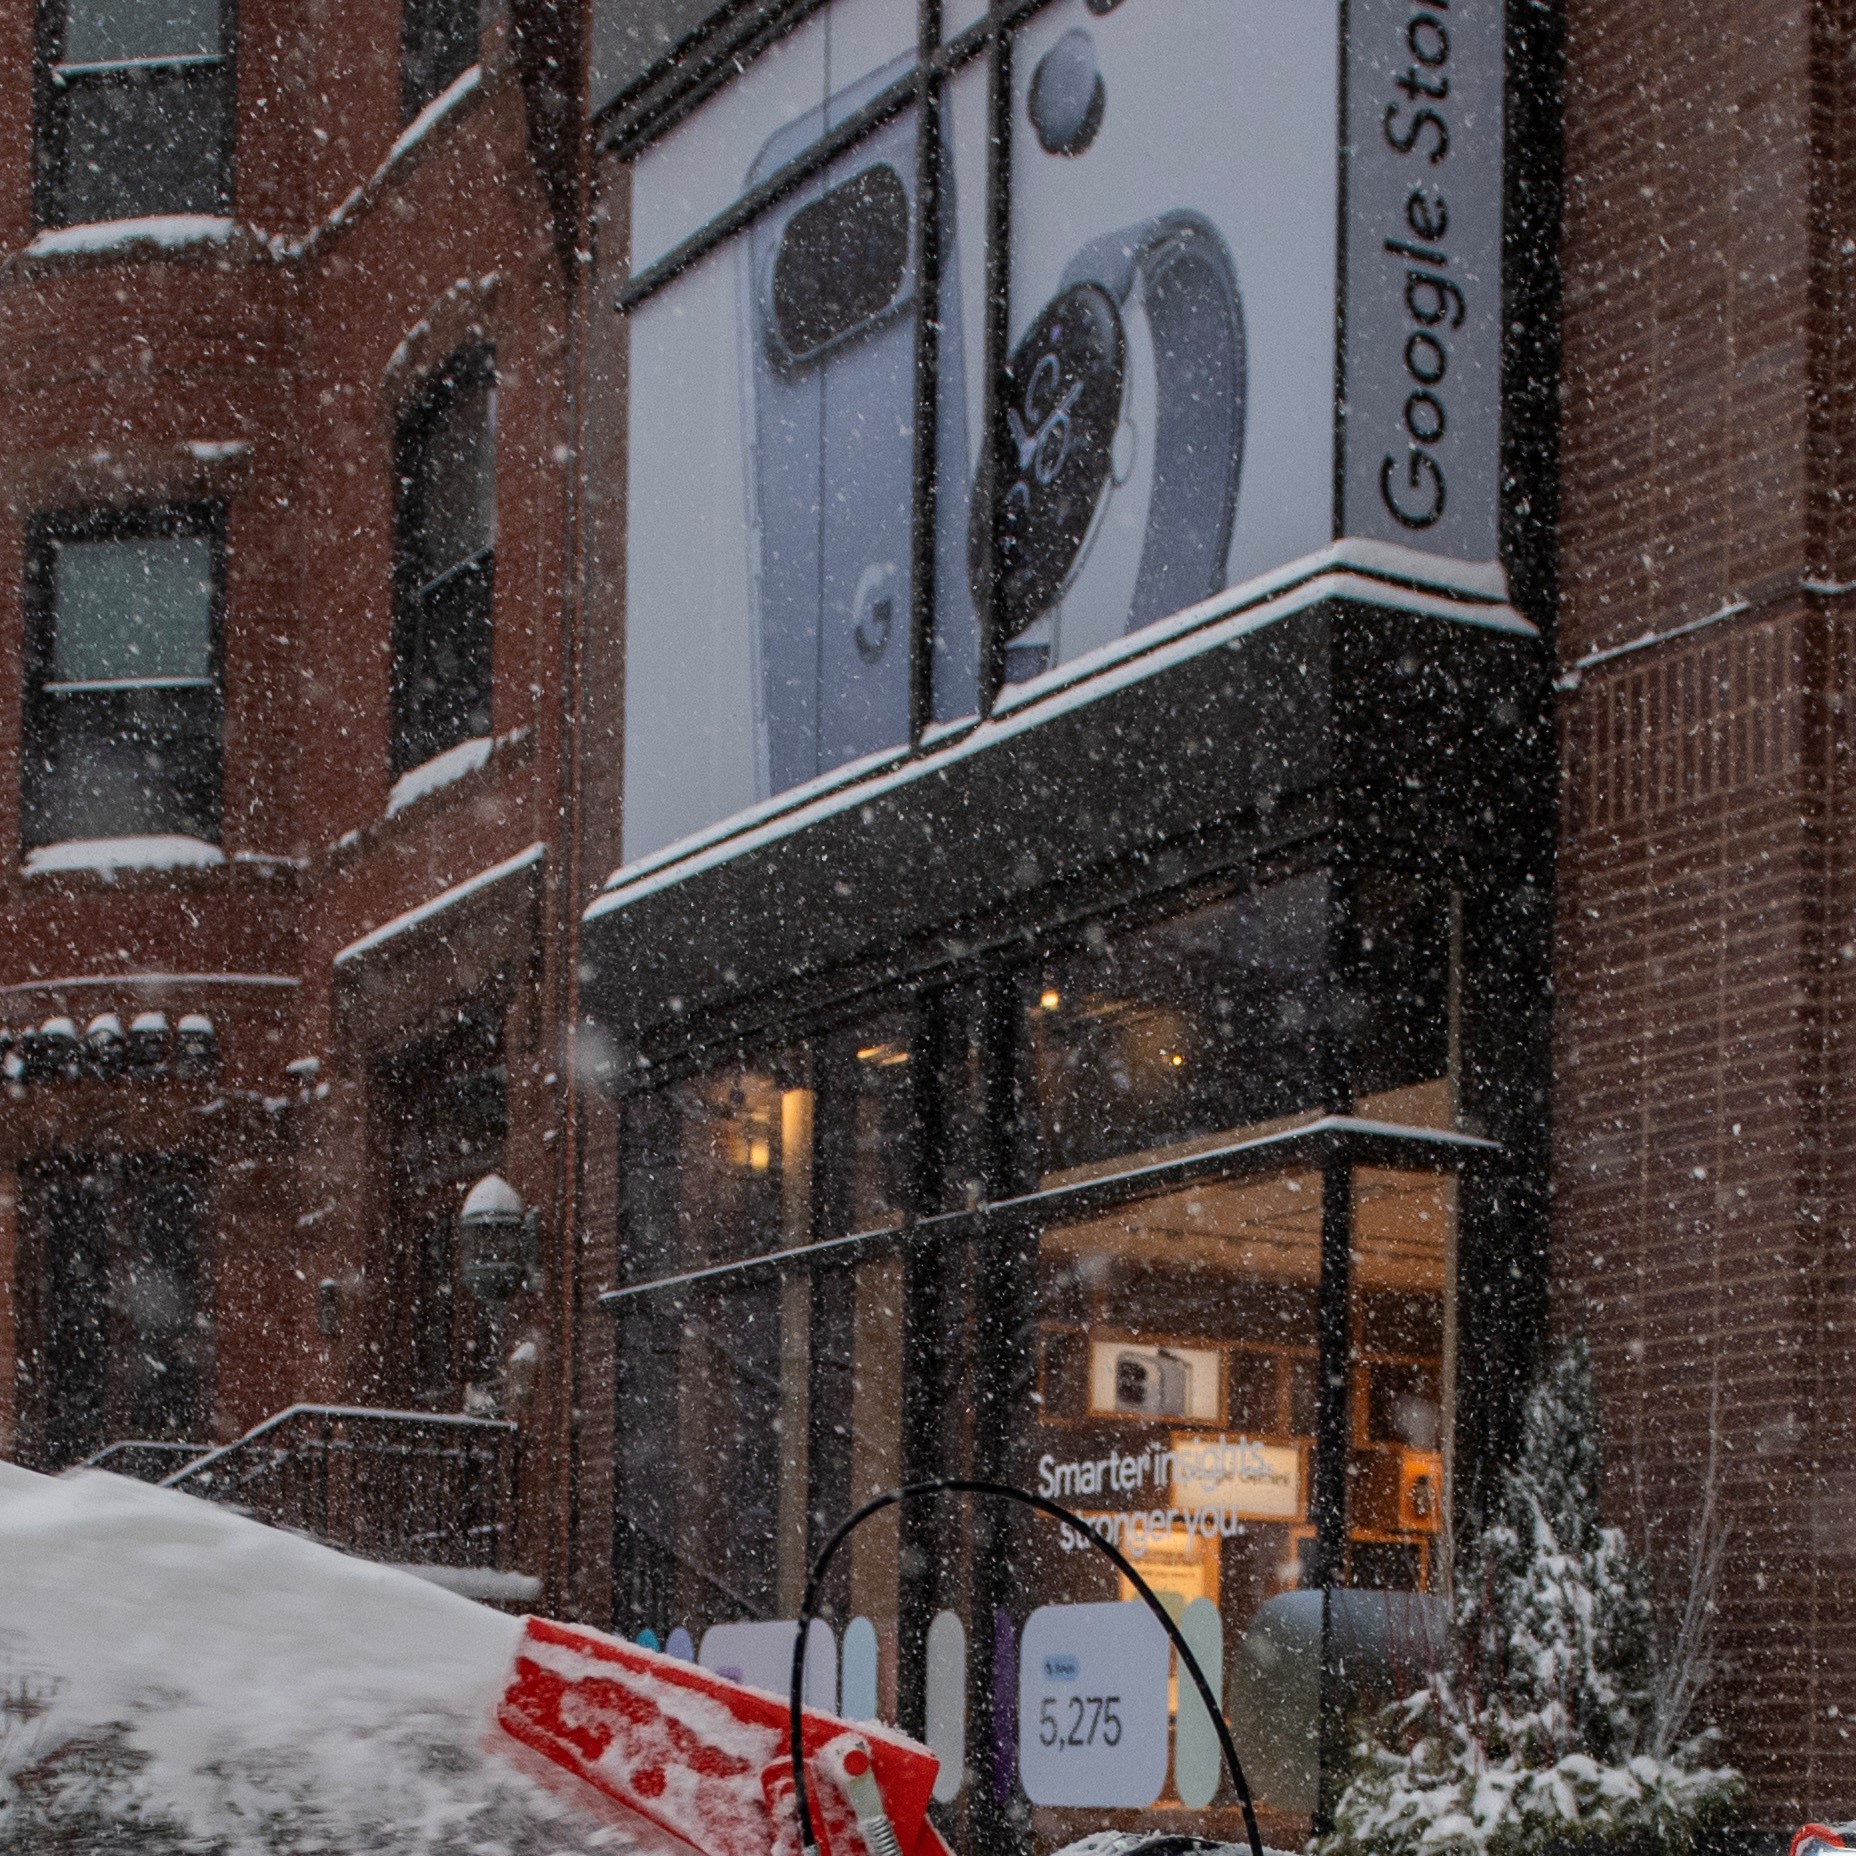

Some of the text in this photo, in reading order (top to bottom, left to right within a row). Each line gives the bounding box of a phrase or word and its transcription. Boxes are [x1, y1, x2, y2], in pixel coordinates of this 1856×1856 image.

[1380, 190, 1466, 529] Google
[1037, 1449, 1147, 1499] Smarter
[1059, 1503, 1245, 1557] stronger you.
[1039, 1695, 1122, 1752] 5,275
